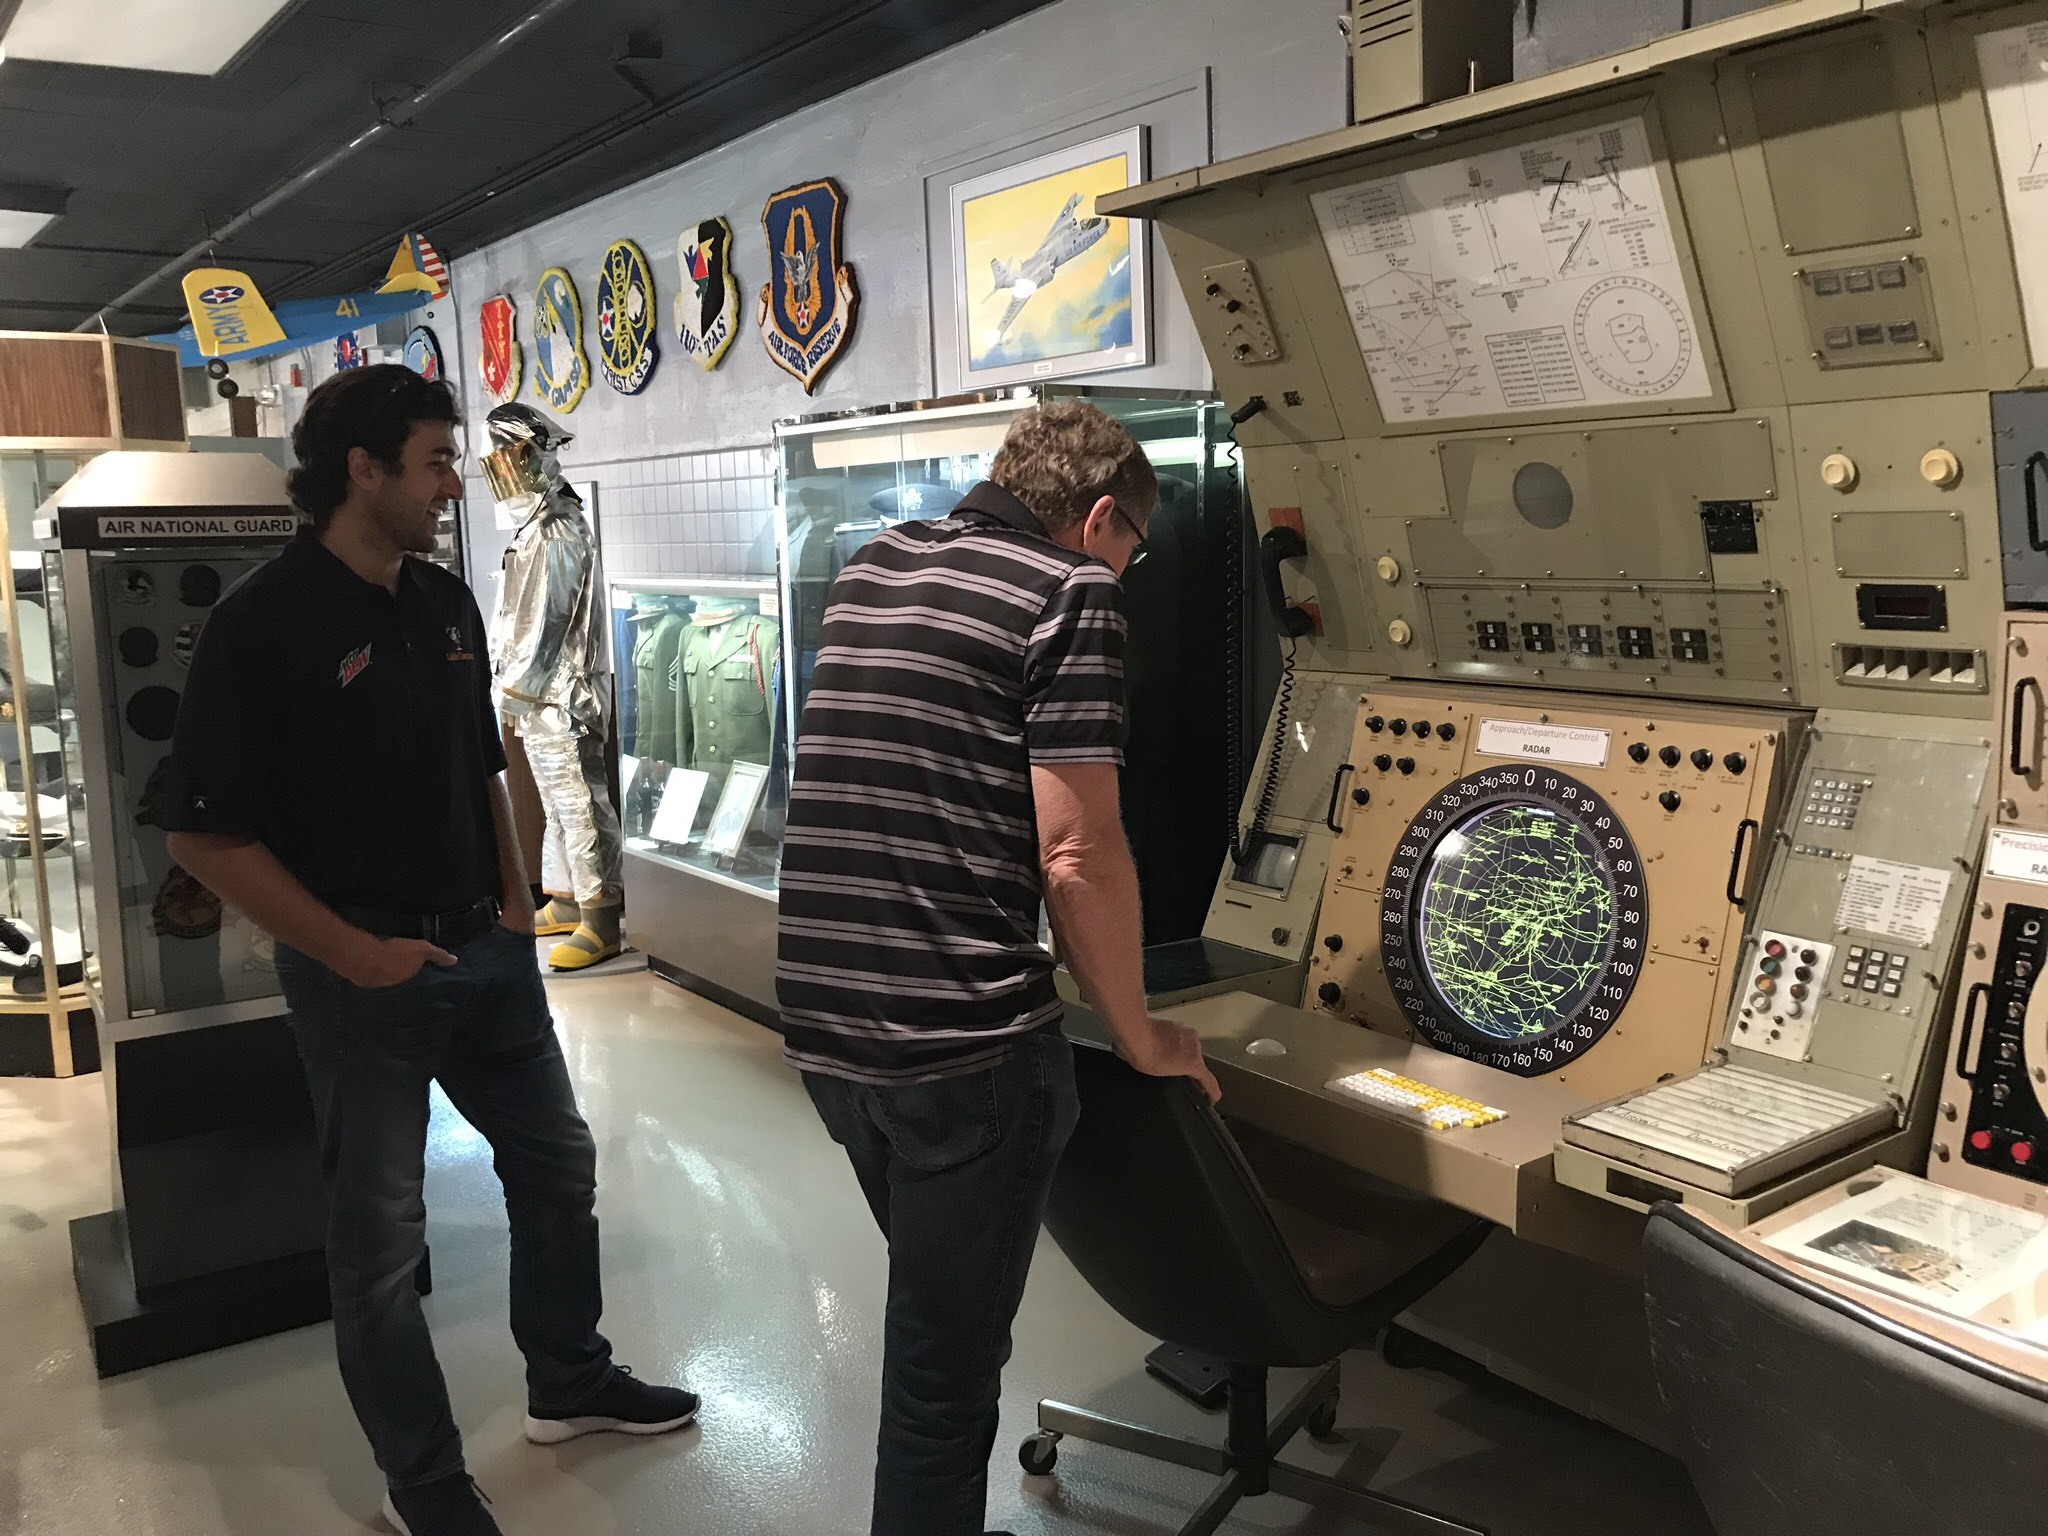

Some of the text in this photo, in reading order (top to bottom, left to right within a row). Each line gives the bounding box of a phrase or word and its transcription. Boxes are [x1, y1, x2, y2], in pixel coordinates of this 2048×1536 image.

[335, 298, 360, 319] 41
[203, 304, 249, 345] ARMY
[783, 341, 807, 377] FORCE
[806, 317, 841, 369] RESERVE
[104, 519, 293, 534] AIR NATIONAL GUARD
[1489, 723, 1600, 742] Approach/Departure Control
[1522, 743, 1551, 755] RADAR
[1479, 775, 1498, 789] 340
[1499, 772, 1519, 785] 350
[1524, 769, 1536, 786] 0
[1544, 778, 1557, 790] 10
[1459, 783, 1479, 796] 330
[1562, 786, 1577, 799] 20
[1441, 794, 1460, 807] 320
[1580, 799, 1595, 812] 30
[1425, 808, 1444, 821] 310
[1595, 817, 1610, 829] 40
[1411, 826, 1430, 839] 300
[1608, 836, 1623, 849] 50
[1400, 844, 1418, 858] 290
[1391, 865, 1409, 879] 280
[1617, 859, 1632, 873] 60
[1384, 887, 1401, 900] 270
[1623, 884, 1638, 898] 70
[1383, 910, 1401, 924] 260
[1623, 910, 1640, 924] 80
[1384, 933, 1402, 947] 250
[1622, 936, 1637, 950] 90
[1388, 955, 1406, 970] 240
[1613, 961, 1634, 977] 100
[1395, 977, 1413, 991] 230
[1603, 984, 1623, 1000] 110
[1405, 997, 1424, 1011] 220
[1588, 1005, 1609, 1021] 120
[1417, 1014, 1436, 1029] 210
[1433, 1029, 1452, 1044] 200
[1572, 1023, 1593, 1039] 130
[1452, 1041, 1470, 1056] 190
[1553, 1037, 1574, 1053] 140
[1472, 1051, 1489, 1064] 180
[1491, 1053, 1511, 1068] 170
[1512, 1052, 1532, 1067] 160
[1533, 1047, 1553, 1062] 150
